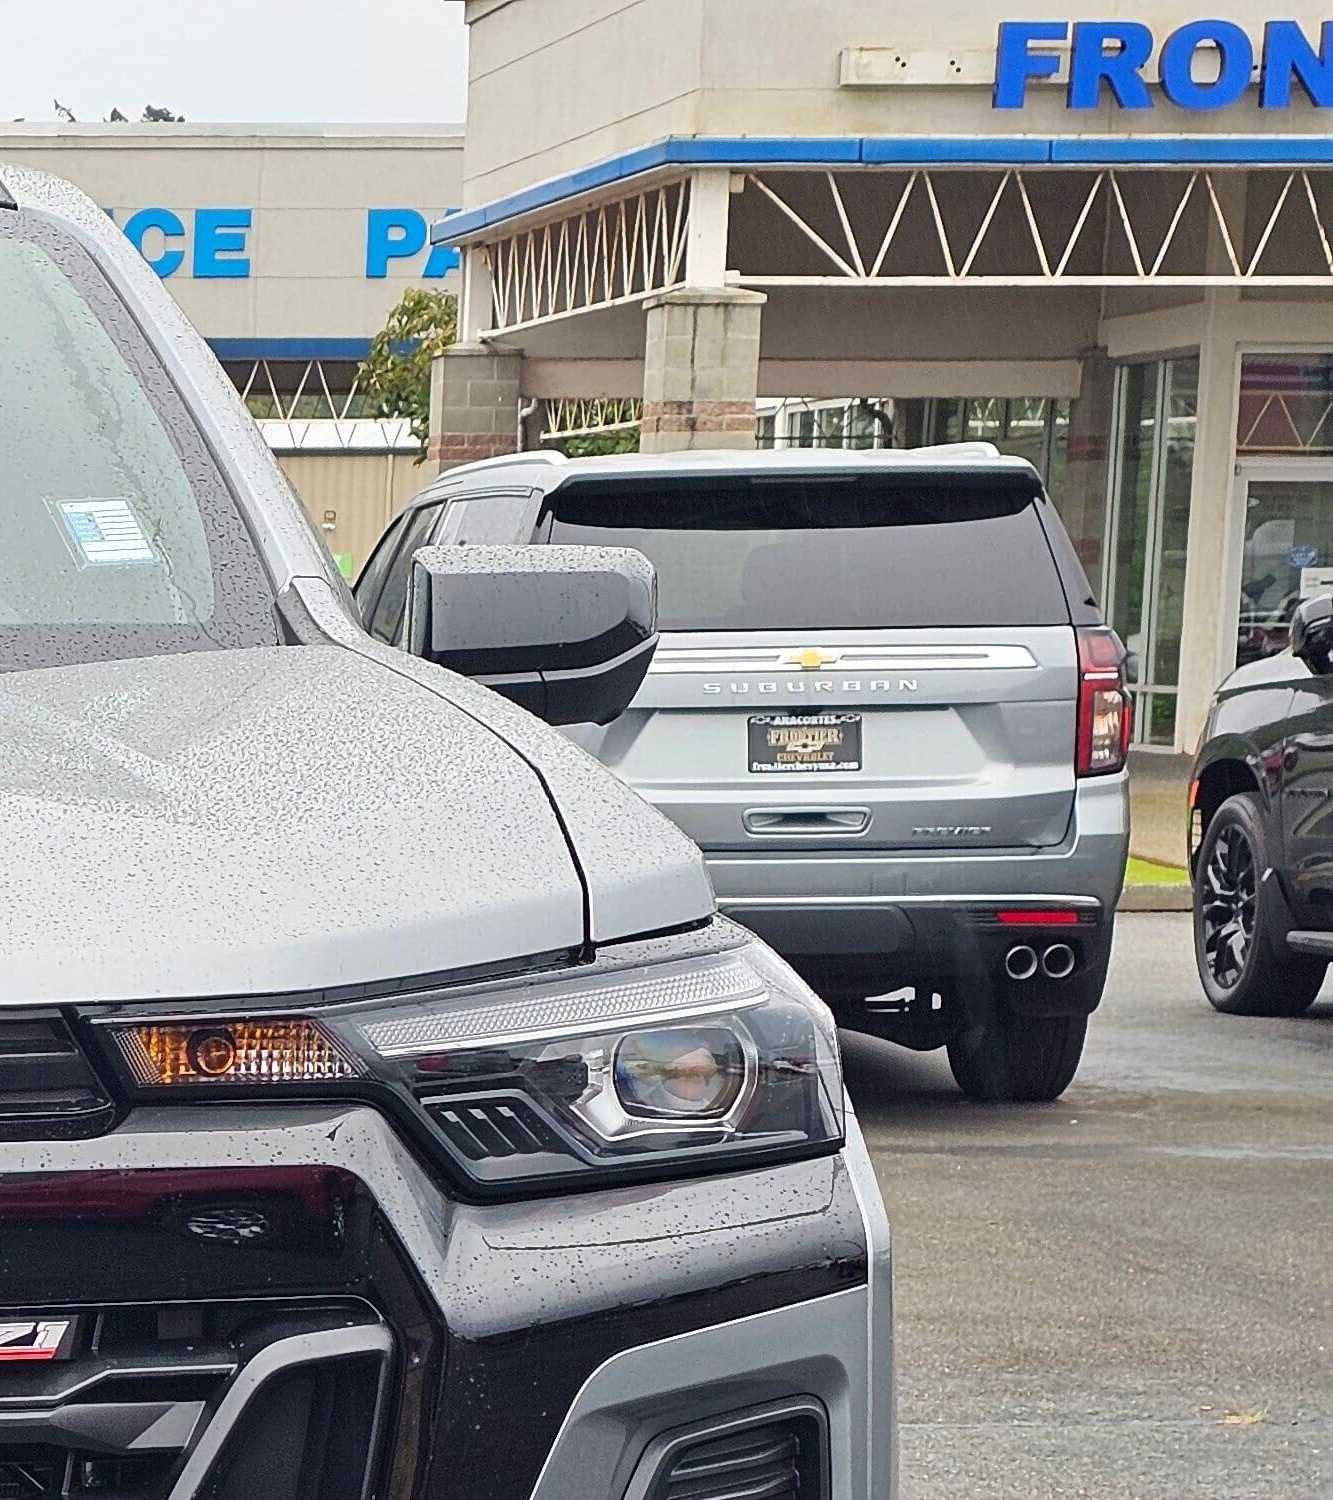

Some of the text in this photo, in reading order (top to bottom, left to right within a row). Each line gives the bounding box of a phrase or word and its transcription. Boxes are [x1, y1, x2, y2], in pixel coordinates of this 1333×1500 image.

[106, 208, 252, 279] CE
[702, 679, 918, 694] SUBURBAN
[776, 751, 835, 762] CHEVROLET
